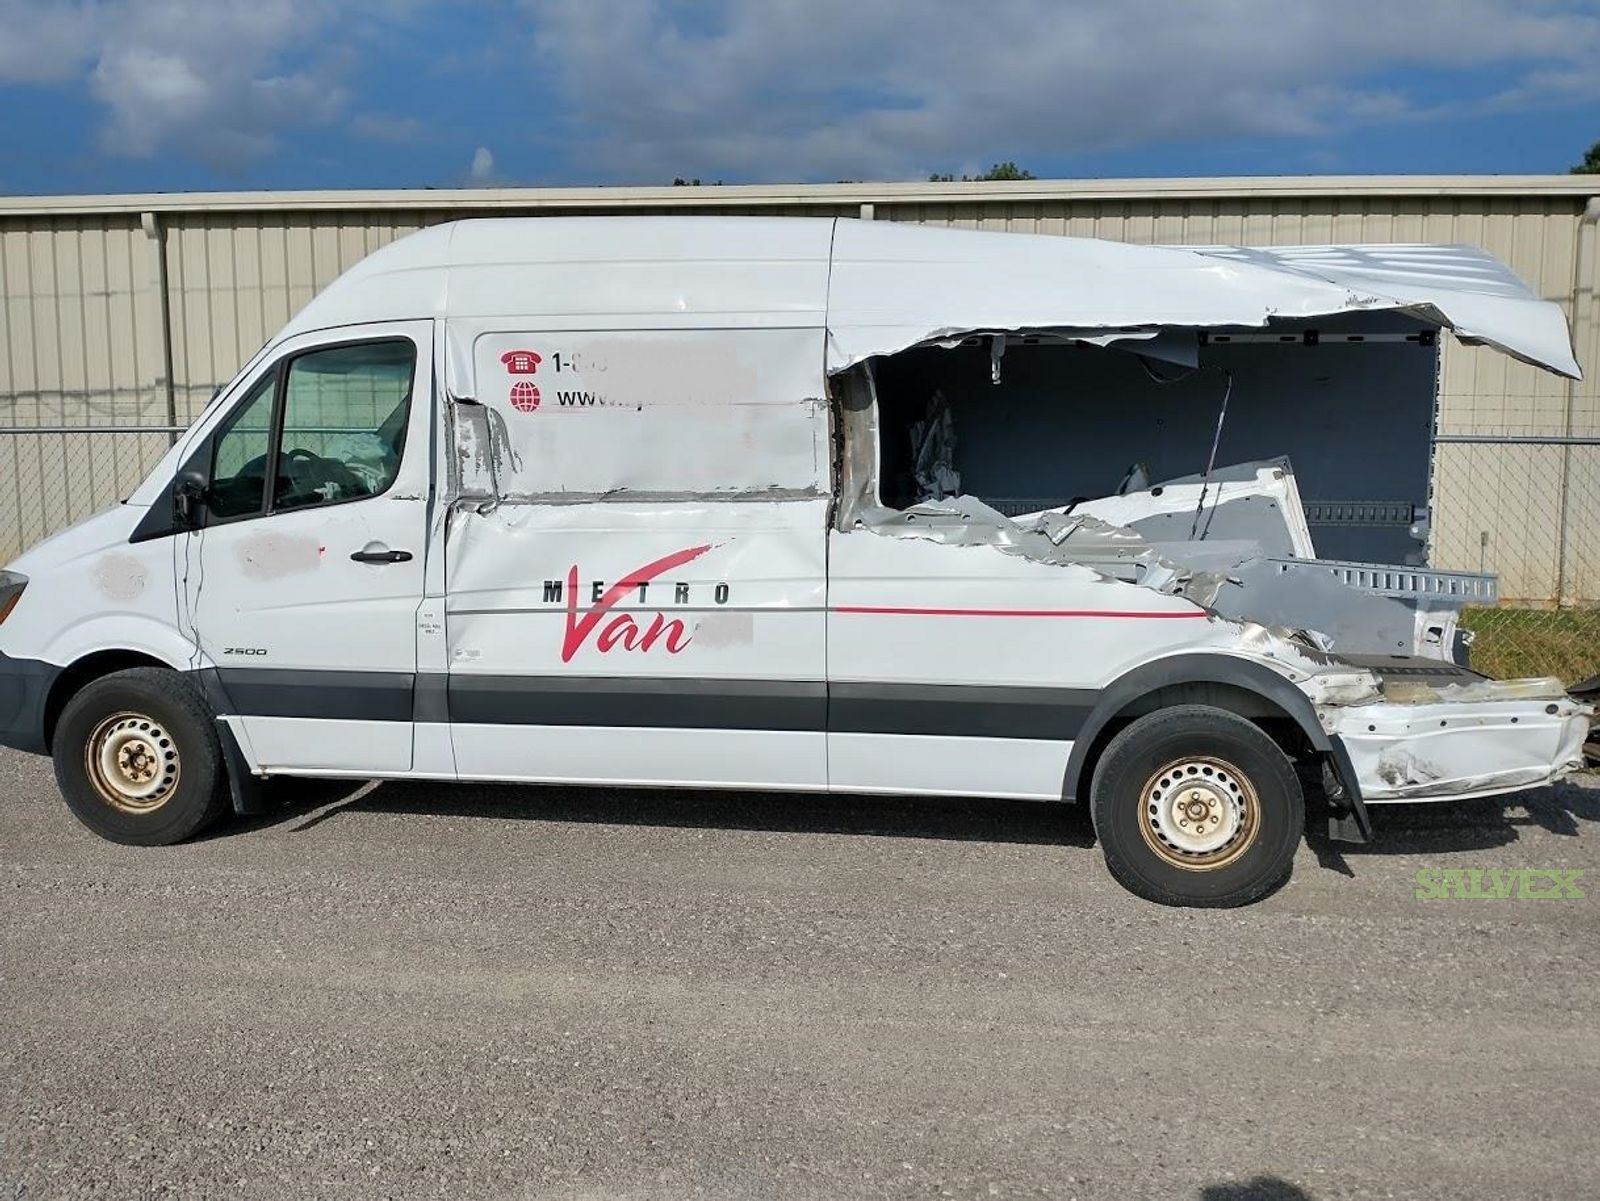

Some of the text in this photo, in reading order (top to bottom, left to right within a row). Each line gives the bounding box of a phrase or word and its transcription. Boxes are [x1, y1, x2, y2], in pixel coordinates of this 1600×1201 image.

[542, 580, 730, 605] METRO
[561, 543, 714, 663] Van
[223, 647, 267, 656] 2500
